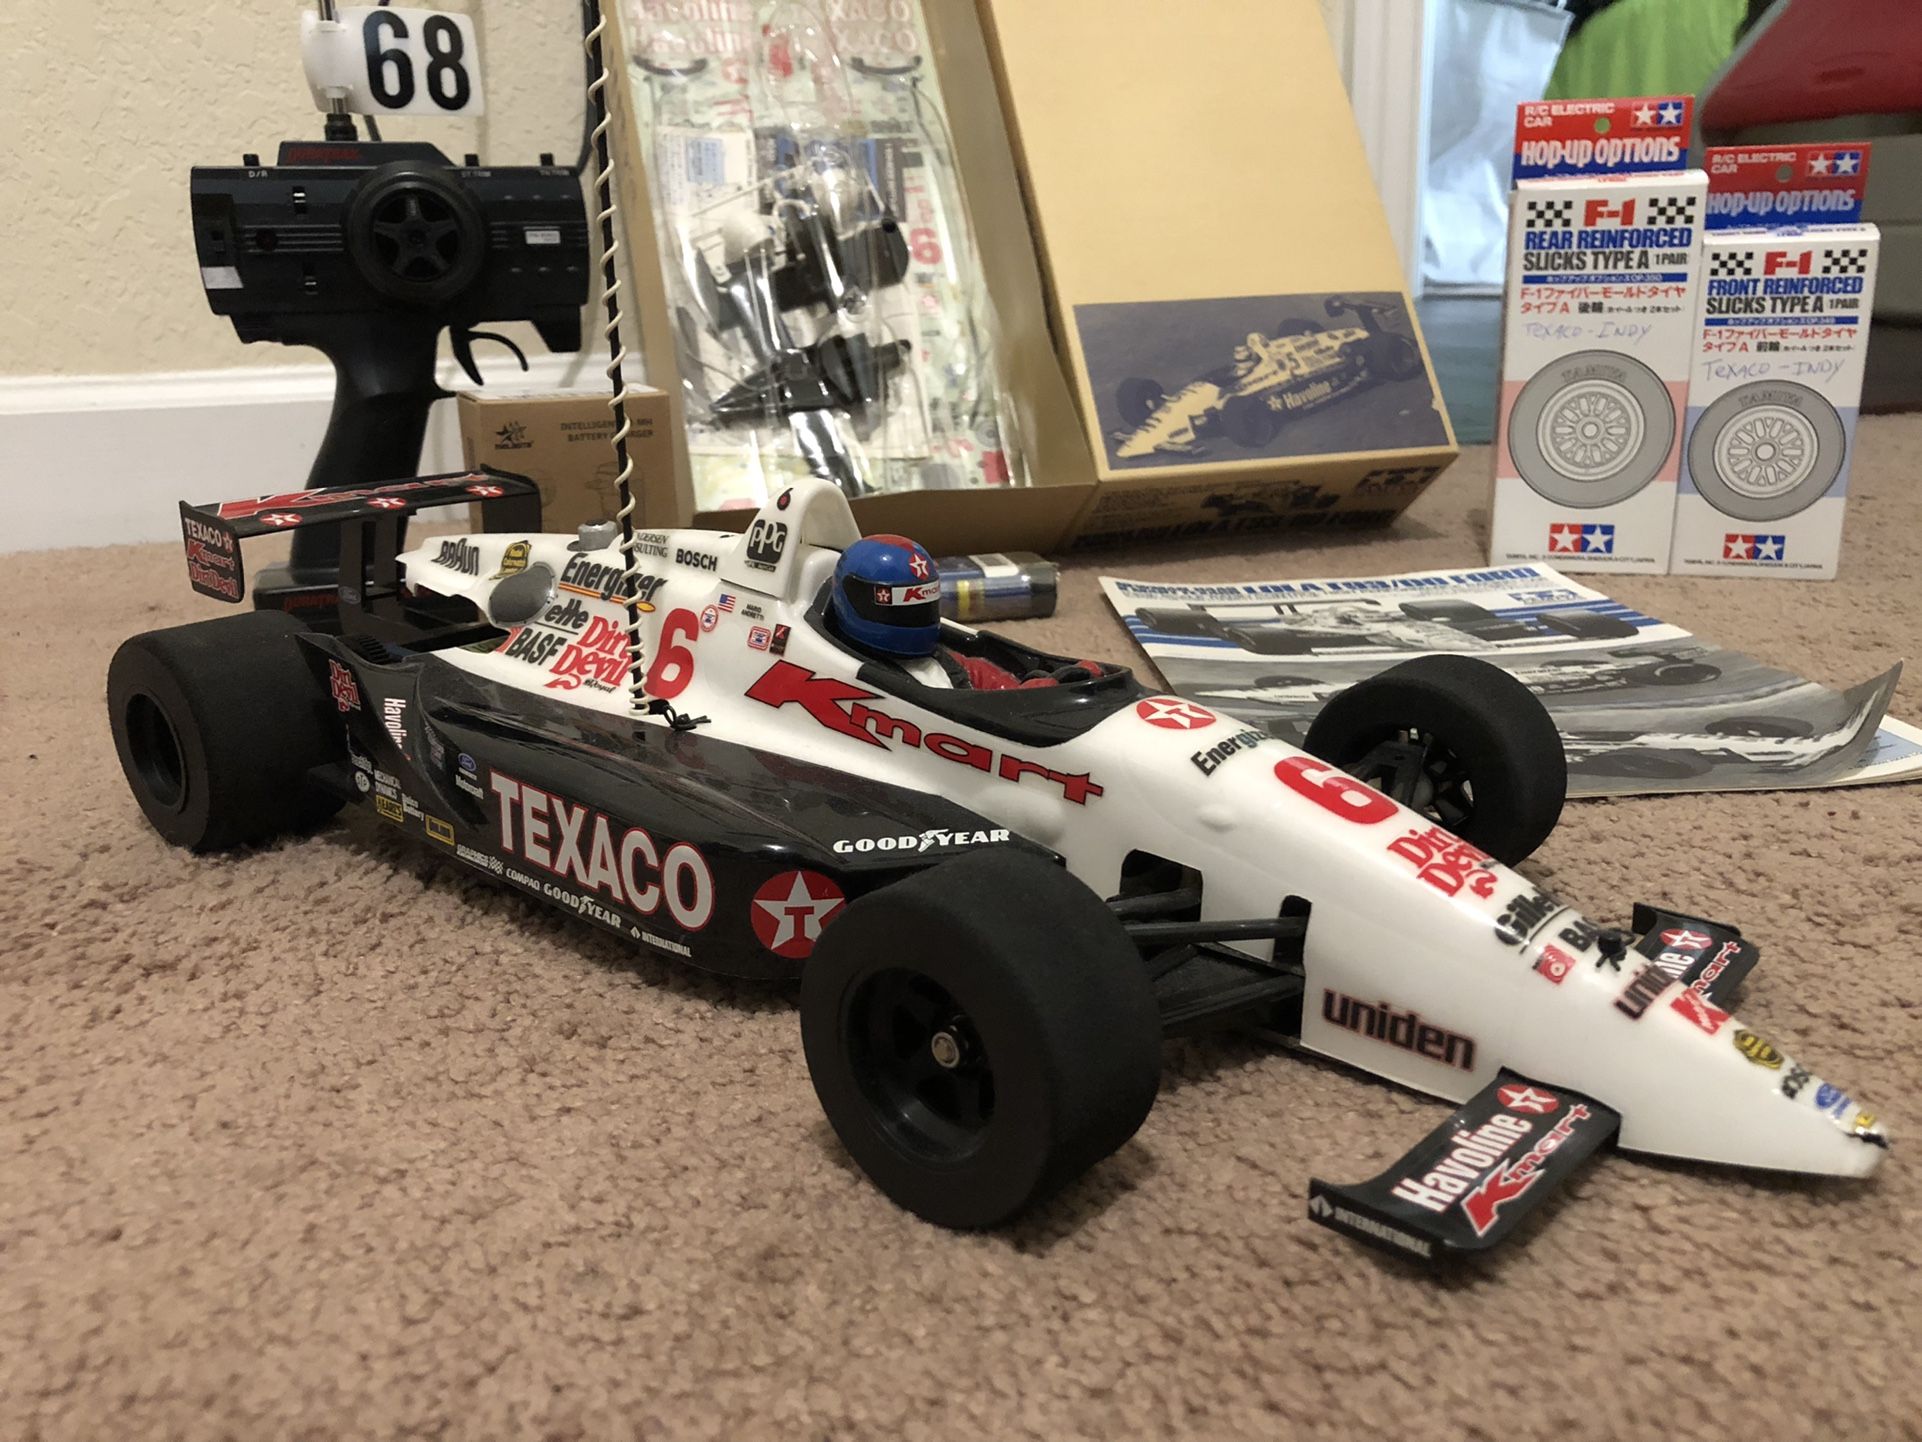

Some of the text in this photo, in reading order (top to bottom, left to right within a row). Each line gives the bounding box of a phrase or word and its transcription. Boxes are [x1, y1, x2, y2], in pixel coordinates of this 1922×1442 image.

[362, 9, 471, 111] 68
[1524, 102, 1616, 116] R/C ELECTRIC
[1524, 116, 1553, 128] CAR
[1711, 151, 1797, 164] R/C ELECTRIC
[1711, 164, 1739, 174] CAR
[1584, 197, 1636, 228] F-1
[1525, 229, 1573, 250] REAR
[1576, 227, 1692, 250] REINFORCED
[1522, 250, 1587, 272] SLICKS
[1590, 249, 1635, 271] TYPE
[1636, 249, 1650, 270] A
[1763, 250, 1813, 276] F-1
[1707, 276, 1864, 297] FRONT REINFORCED
[1705, 296, 1766, 315] SLICKS
[1770, 295, 1811, 314] TYPE
[1811, 295, 1824, 313] A
[560, 420, 617, 431] INTELLIGEN
[184, 517, 223, 548] TEXACO
[750, 521, 786, 555] PPG
[675, 548, 718, 572] BOSCH
[504, 627, 567, 667] BASF
[643, 607, 700, 700] 6
[549, 644, 633, 687] Devil
[744, 658, 1104, 806] Kmart
[1273, 755, 1399, 825] 6
[489, 768, 716, 933] TEXACO
[832, 828, 1011, 854] GOODYEAR
[505, 867, 542, 892] COMPAQ
[543, 883, 623, 929] GOODYEAR
[1322, 987, 1478, 1072] uniden
[1391, 1112, 1534, 1213] Havoline
[1460, 1103, 1592, 1238] Kmart
